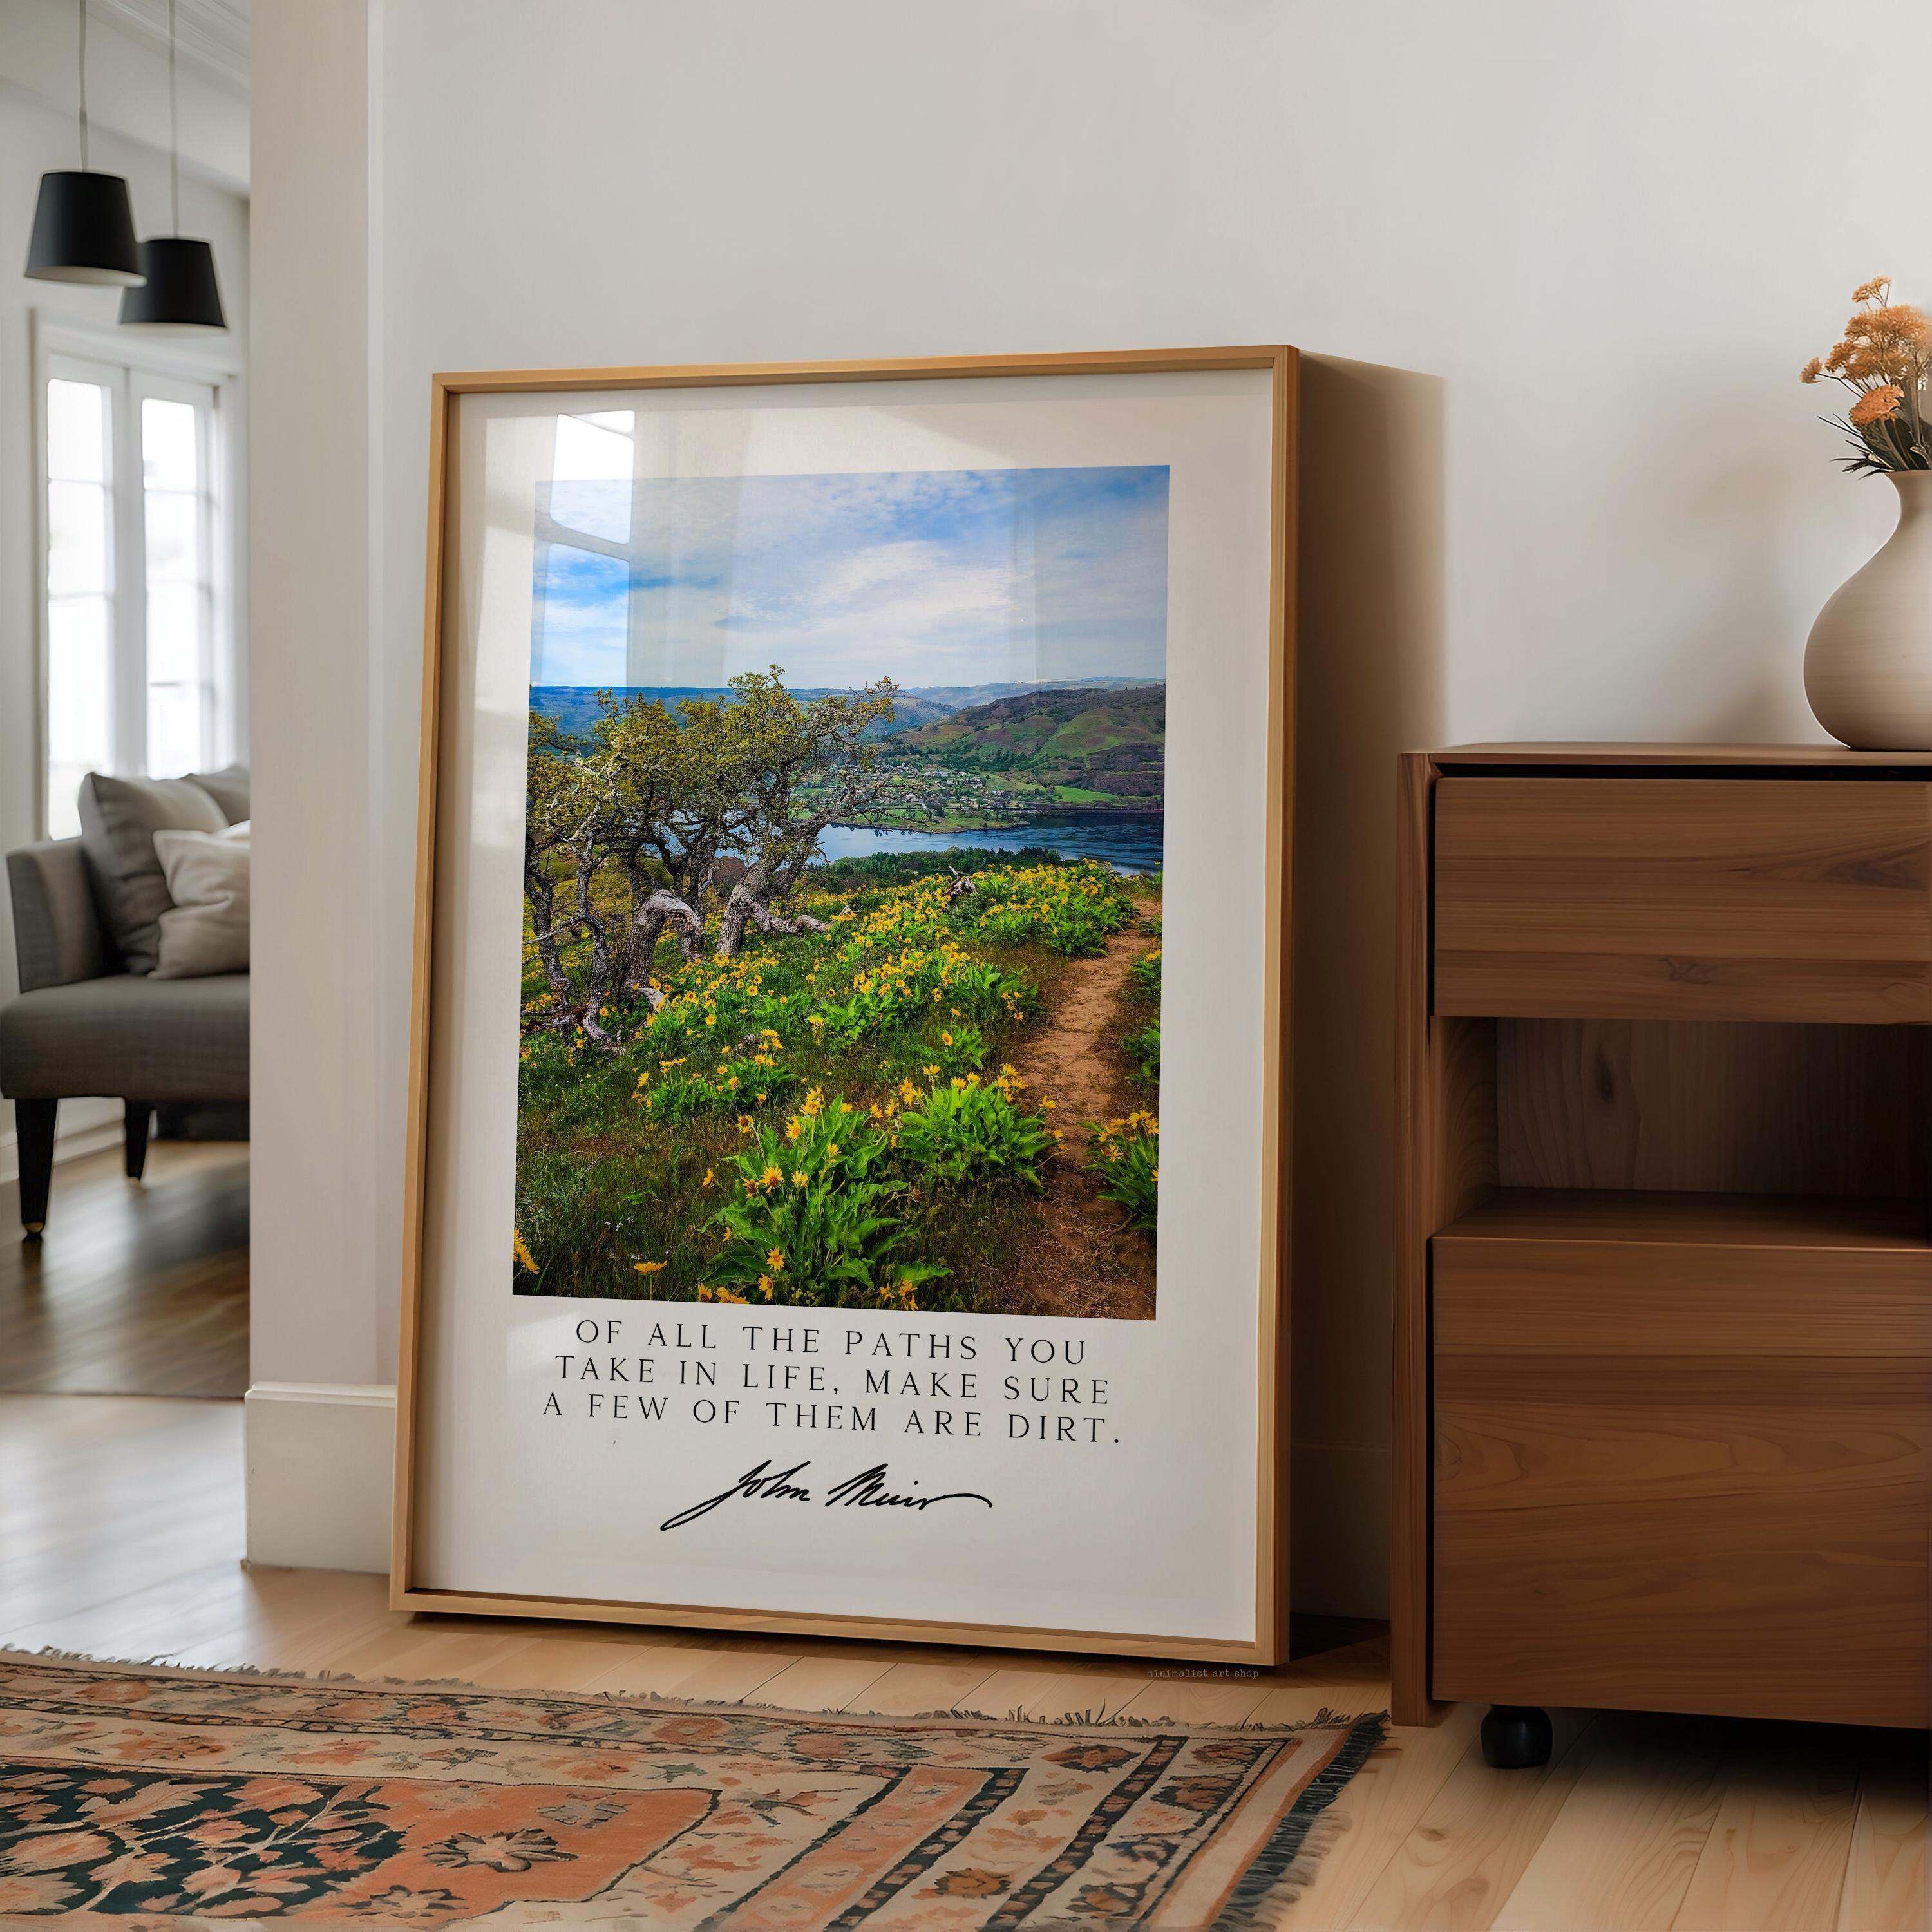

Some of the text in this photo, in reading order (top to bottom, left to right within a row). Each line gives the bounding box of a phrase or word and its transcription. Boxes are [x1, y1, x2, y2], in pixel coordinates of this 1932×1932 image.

[576, 1320, 1086, 1365] OF ALL THE PATHS YOU
[555, 1355, 1109, 1405] TAKE IN LIFE, MAKE SURE
[542, 1392, 1121, 1443] A FEW OF THEM ARE DIRT.
[660, 1459, 993, 1532] John Muir
